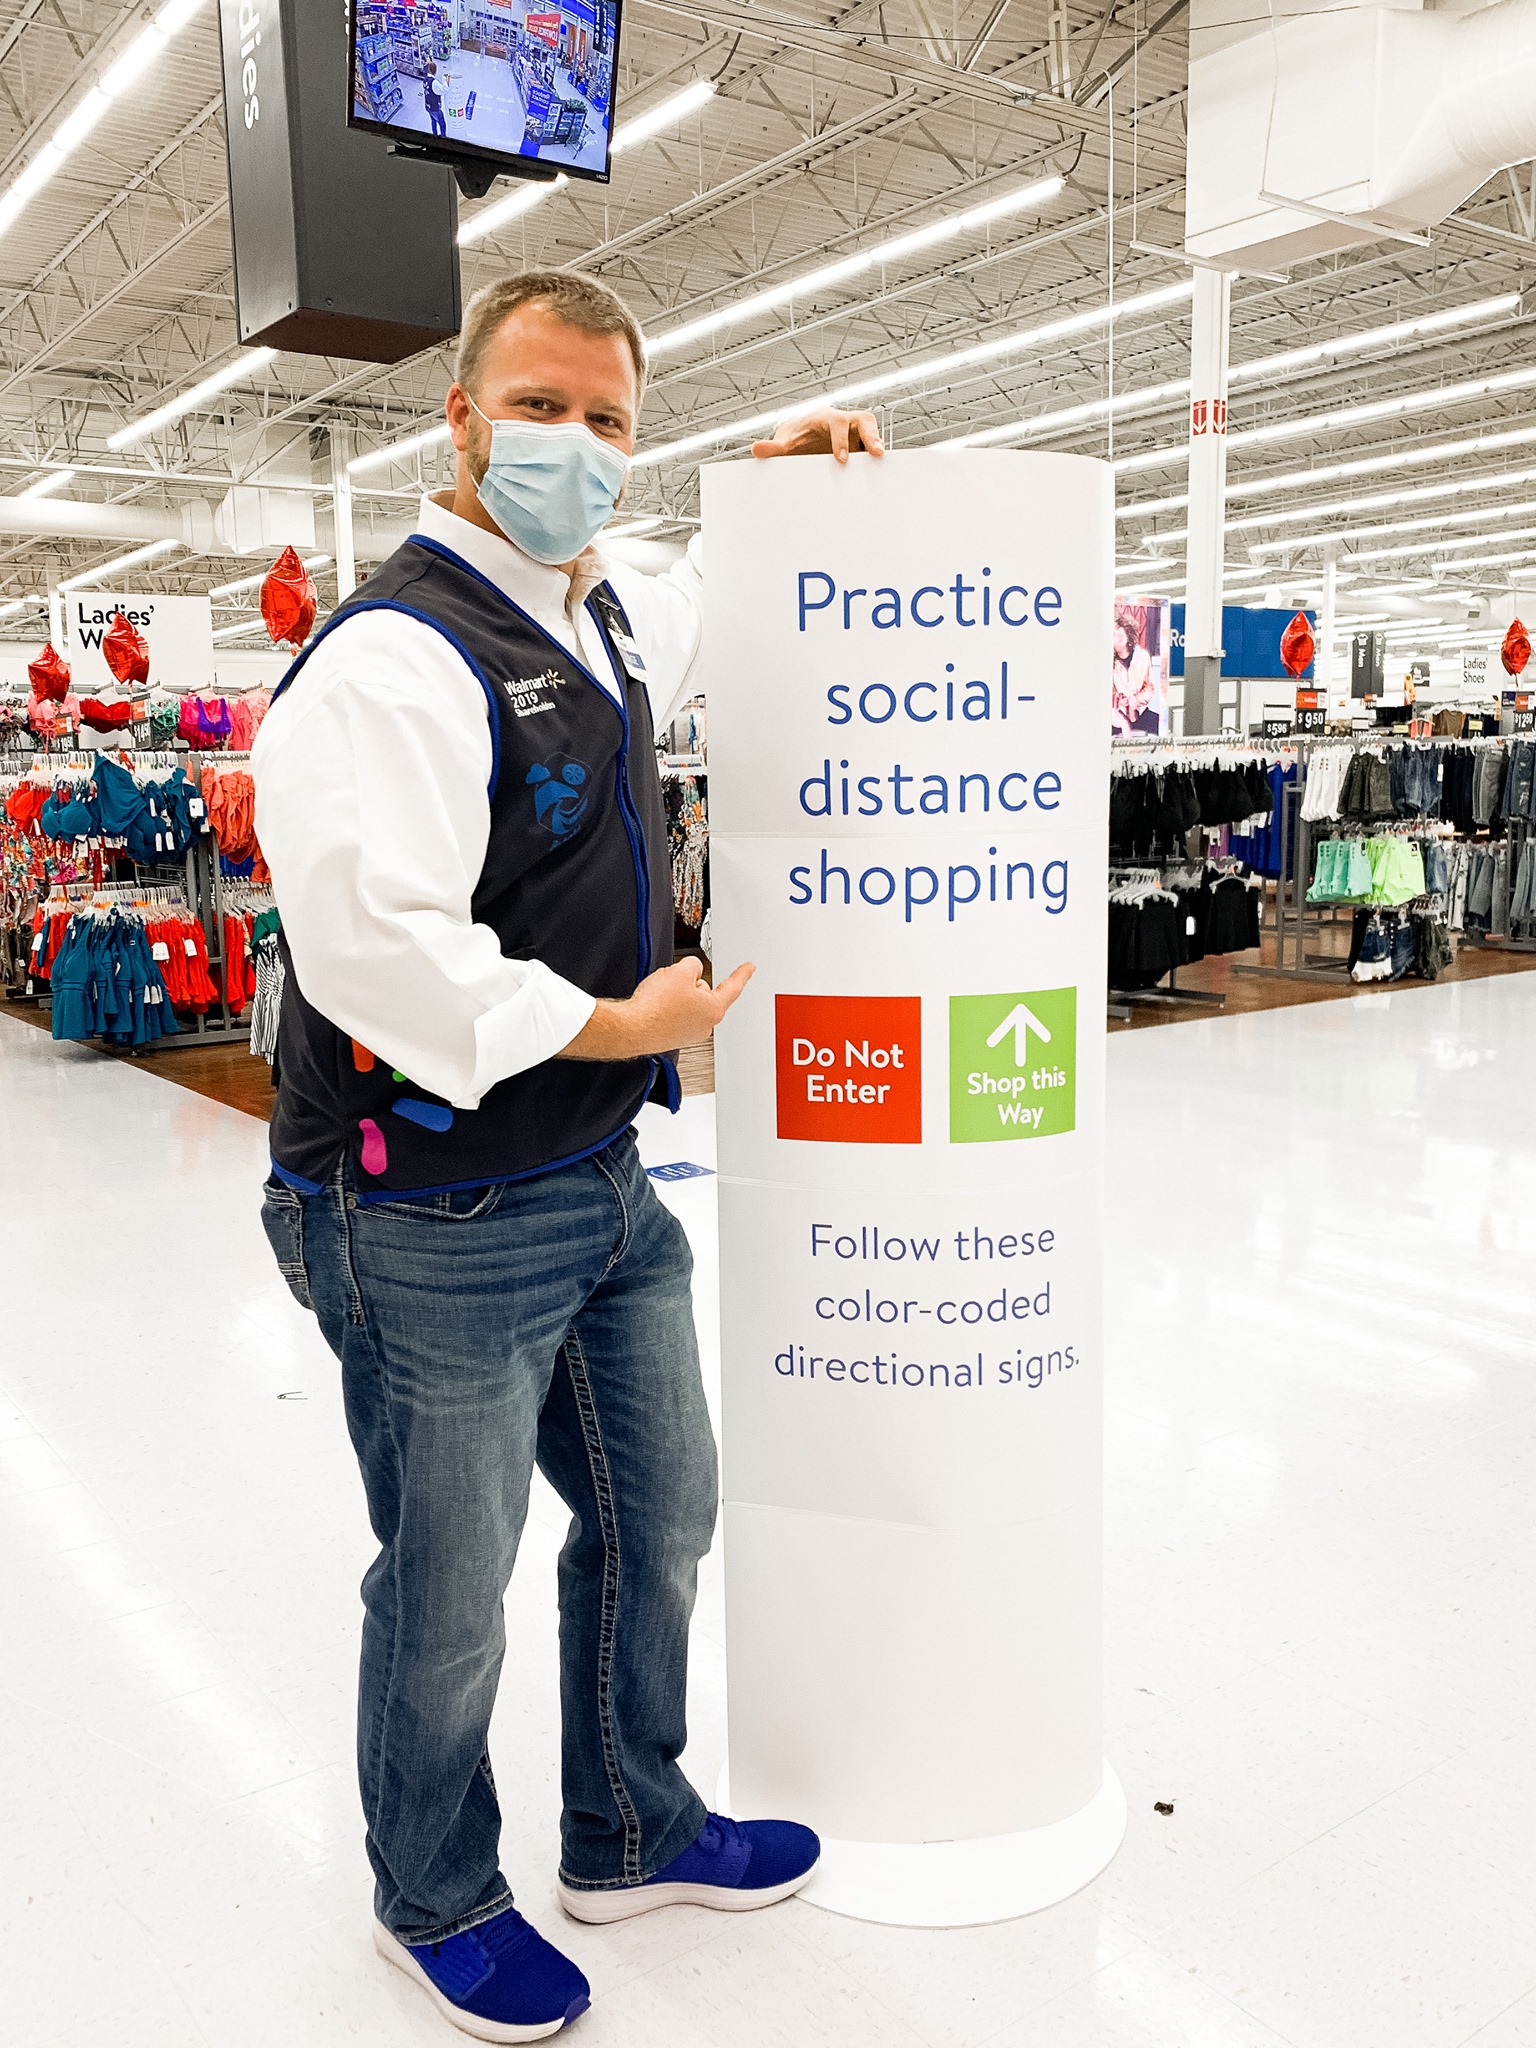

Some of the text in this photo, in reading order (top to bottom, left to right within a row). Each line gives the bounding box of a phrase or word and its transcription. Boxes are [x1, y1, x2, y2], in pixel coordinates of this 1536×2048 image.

[798, 566, 1062, 632] Practice
[1463, 656, 1488, 669] Ladies'
[1463, 670, 1485, 683] Shoes
[503, 674, 549, 696] Walmart
[511, 691, 539, 709] 2019
[827, 661, 1036, 725] social-
[799, 758, 1062, 817] distance
[788, 846, 1068, 923] shopping
[792, 1038, 904, 1069] Do Not
[806, 1074, 891, 1104] Enter
[967, 1065, 1066, 1099] Shop this
[997, 1102, 1044, 1130] Way
[811, 1223, 1055, 1261] Follow these
[815, 1281, 1051, 1325] color-coded
[774, 1344, 1080, 1389] directional signs.
